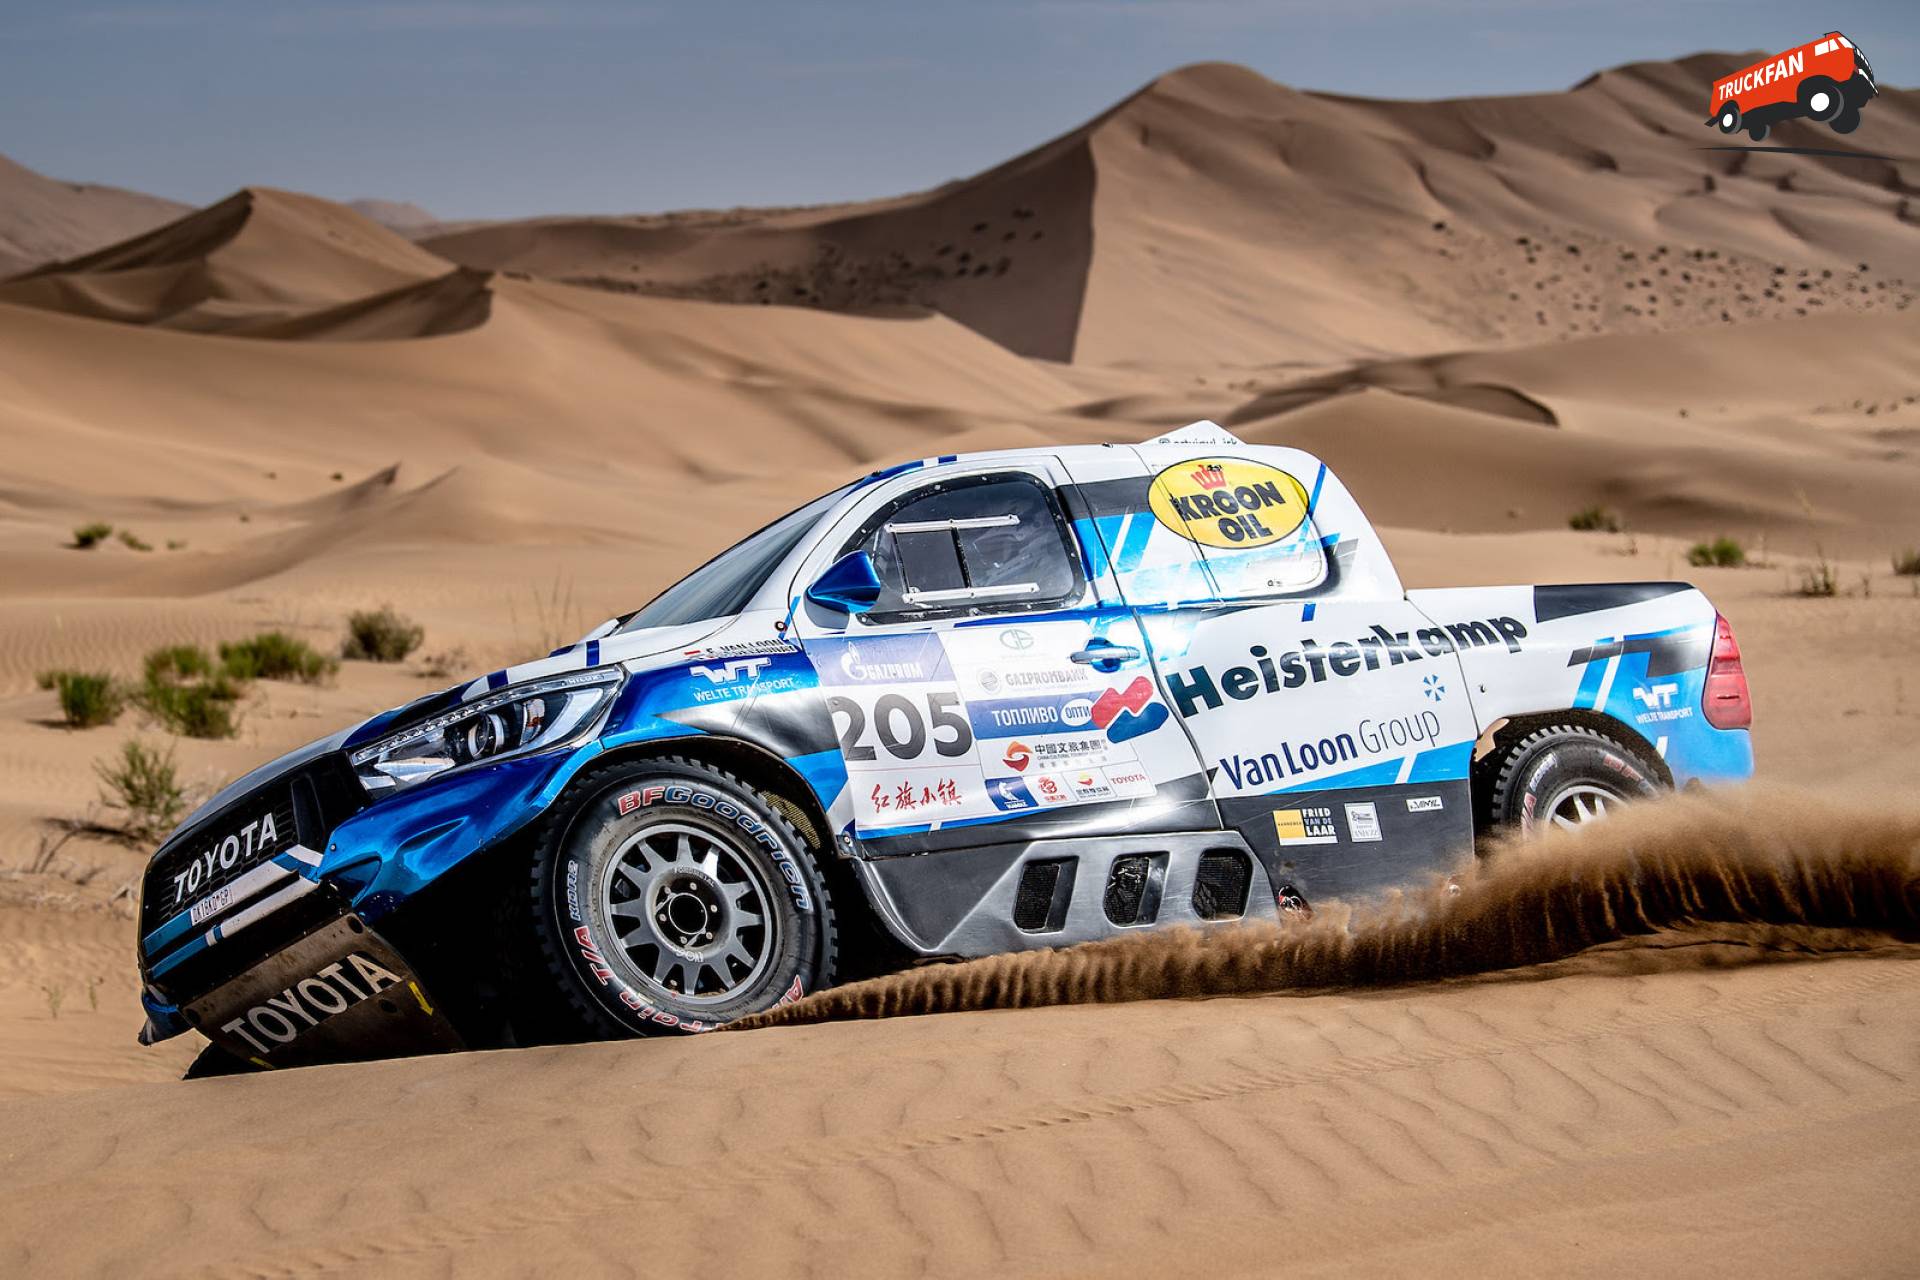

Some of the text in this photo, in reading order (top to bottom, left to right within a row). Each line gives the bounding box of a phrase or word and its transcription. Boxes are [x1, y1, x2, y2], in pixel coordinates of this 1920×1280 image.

[1172, 480, 1286, 521] KROON
[1217, 513, 1274, 542] OIL
[866, 662, 924, 681] GAZPROM
[1004, 668, 1089, 687] GAZPROMBANK
[1164, 615, 1528, 718] Heisterkamp
[693, 677, 794, 702] WELTE TRANSPORT
[828, 692, 973, 761] 205
[991, 705, 1059, 727] ТОПЛИВО
[1358, 710, 1441, 754] Group
[1110, 773, 1146, 785] TOYOTA
[1301, 807, 1331, 818] FRIED
[1304, 817, 1321, 825] VAN
[1322, 817, 1332, 825] DE
[1307, 824, 1336, 836] LAAR
[174, 812, 278, 902] TOYOTA
[617, 785, 811, 911] BFGoodrich
[220, 952, 404, 1054] TOYOTA
